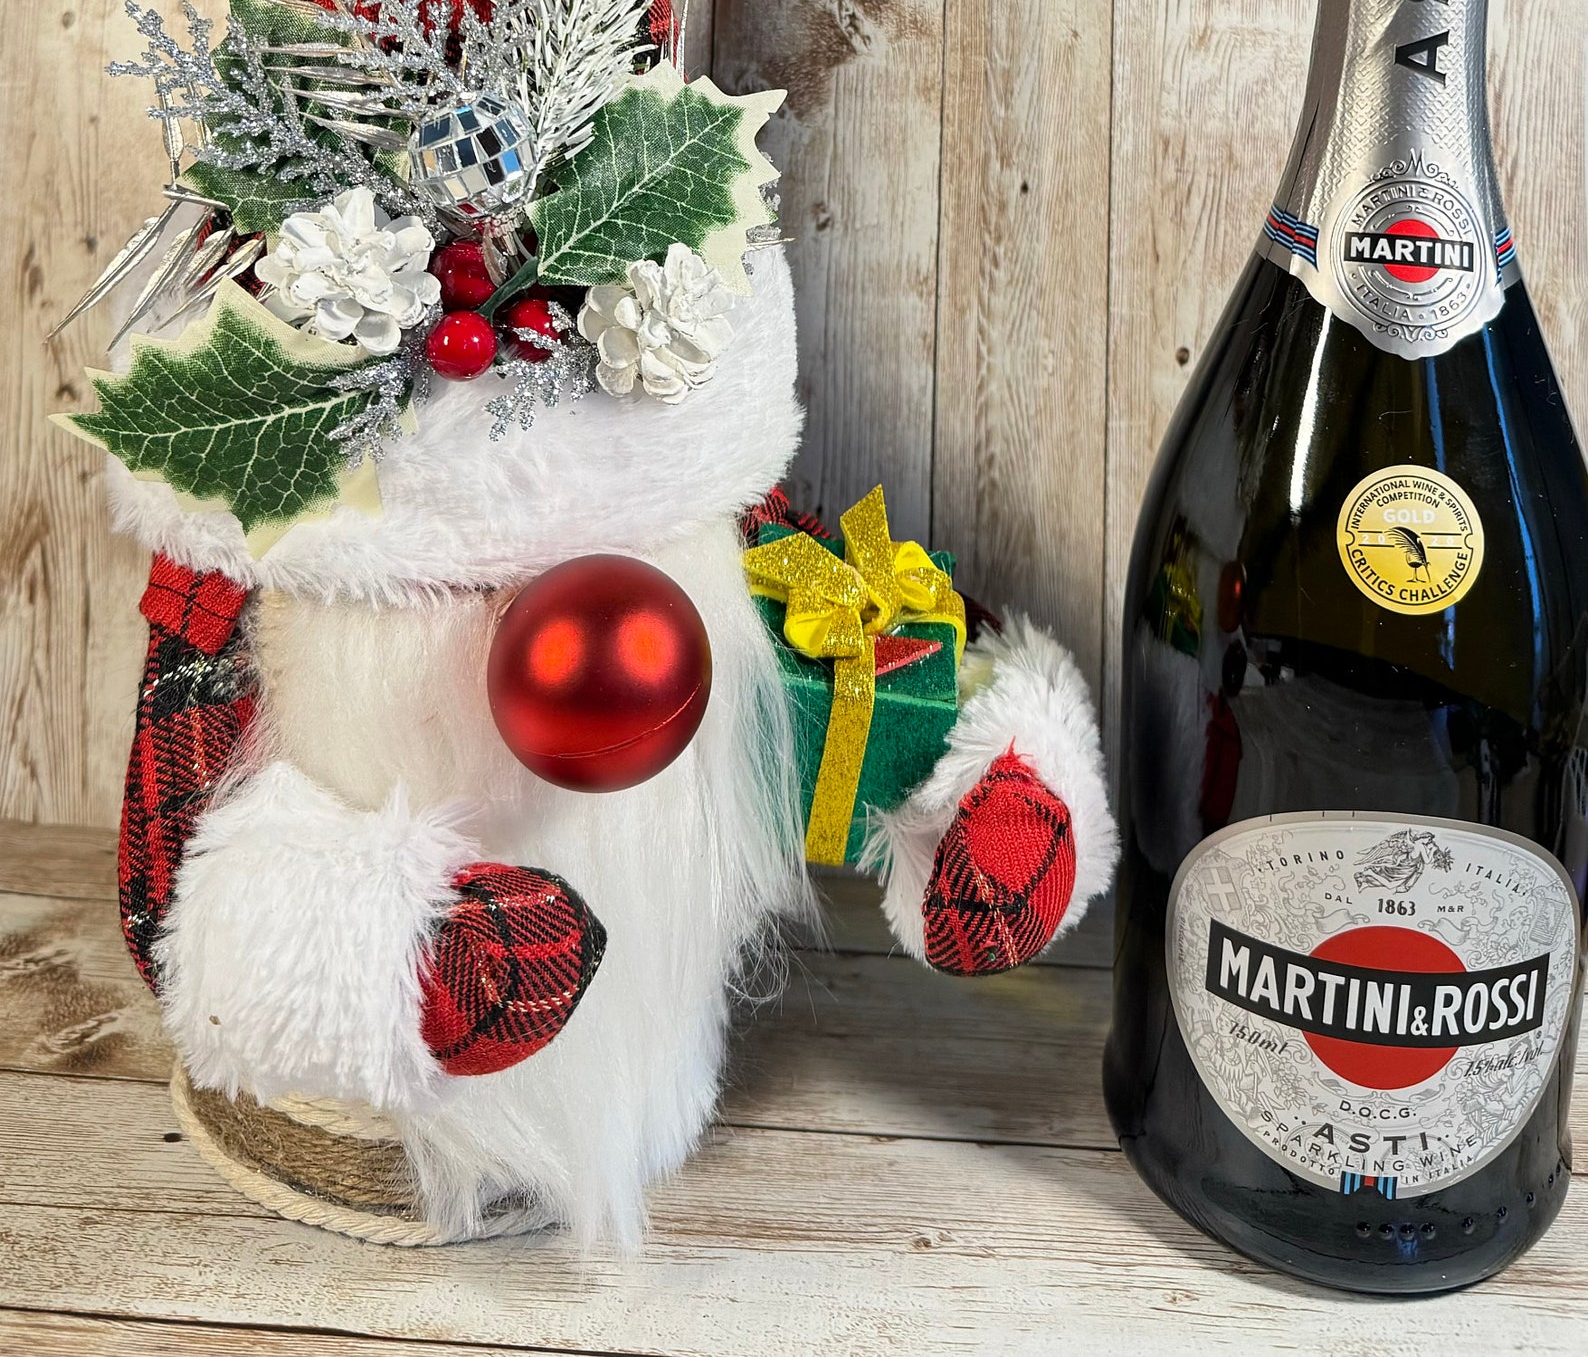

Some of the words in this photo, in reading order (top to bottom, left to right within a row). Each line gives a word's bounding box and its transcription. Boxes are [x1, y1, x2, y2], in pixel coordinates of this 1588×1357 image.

[1351, 184, 1416, 226] MARTINI
[1432, 192, 1473, 235] ROSSI
[1350, 236, 1470, 268] MARTINI
[1355, 282, 1412, 319] ITALIA
[1431, 291, 1468, 320] 1863
[1351, 479, 1411, 530] INTERNATIONAL
[1412, 480, 1439, 496] WINE
[1439, 491, 1446, 501] &
[1445, 498, 1468, 532] SPIRITS
[1376, 491, 1441, 508] COMPETITION
[1383, 508, 1436, 524] GOLD
[1351, 548, 1396, 596] CRITICS
[1399, 551, 1468, 602] CHALLENGE
[1266, 850, 1345, 871] TORINO
[1465, 862, 1522, 893] ITALIA
[1324, 892, 1352, 904] DAL
[1377, 898, 1416, 916] 1863
[1436, 905, 1465, 913] M&R
[1229, 1020, 1289, 1055] 750ml
[1339, 1100, 1417, 1120] D.O.C.G.
[1260, 1110, 1405, 1172] SPARKLING
[1419, 1134, 1477, 1168] WINE
[1311, 1122, 1429, 1156] ASTI
[1263, 1130, 1335, 1176] PRODOTTO
[1405, 1175, 1419, 1184] IN
[1428, 1155, 1474, 1179] ITALIA
